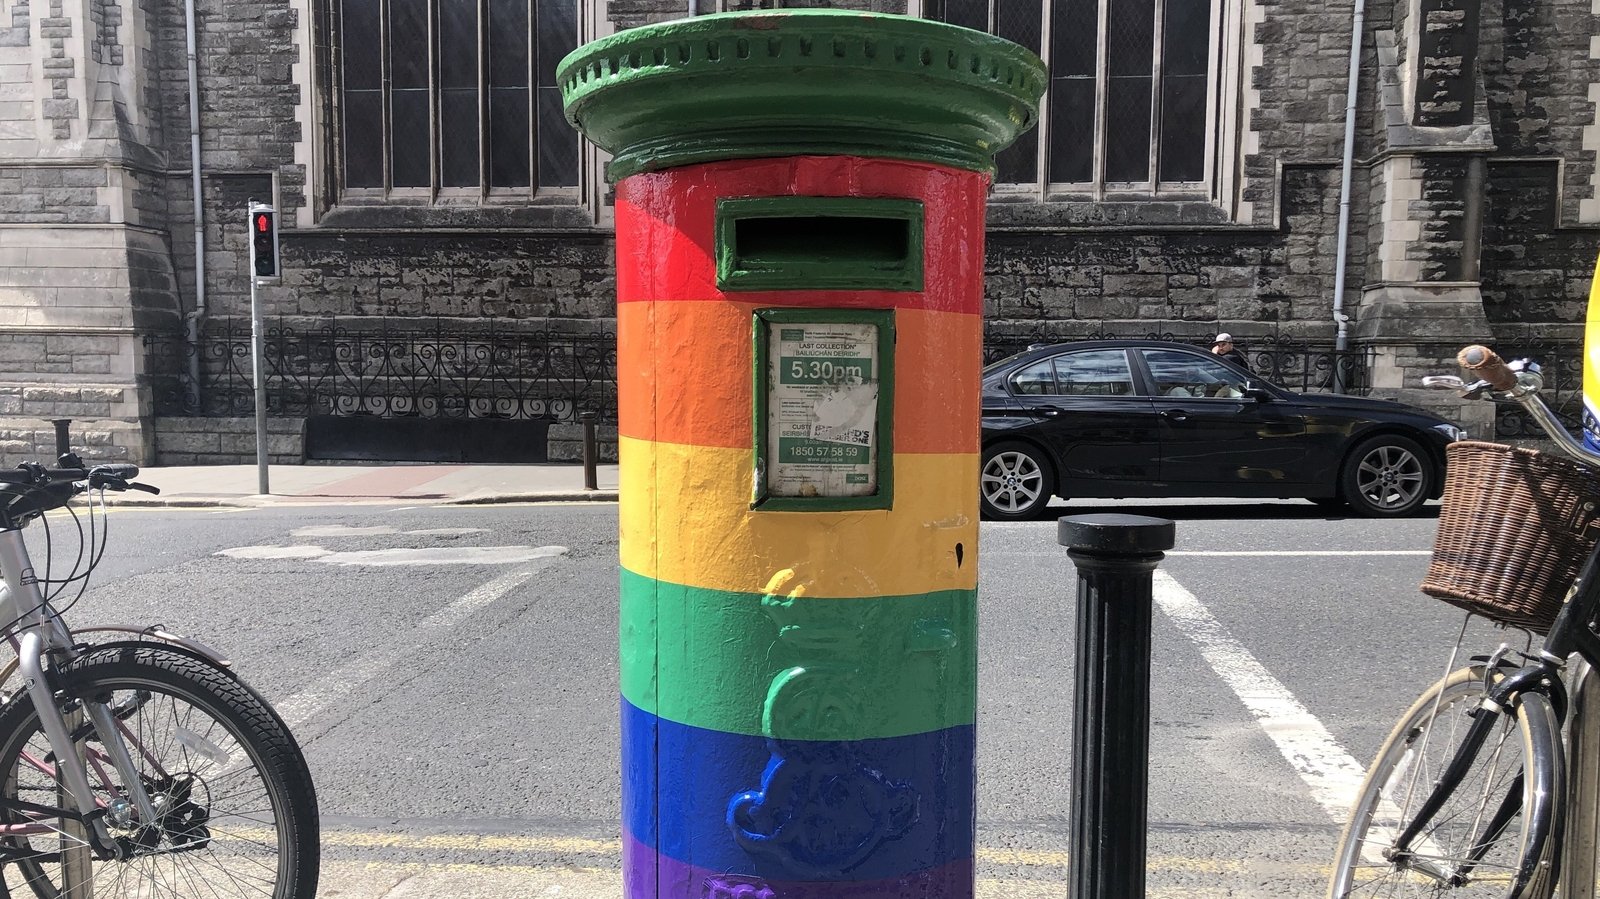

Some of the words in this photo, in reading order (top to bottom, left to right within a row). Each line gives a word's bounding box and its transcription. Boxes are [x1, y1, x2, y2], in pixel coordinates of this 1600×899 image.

[791, 361, 862, 384] 5.30pm
[790, 446, 814, 456] 1850
[816, 446, 829, 456] 57
[831, 447, 844, 457] 58
[845, 447, 858, 457] 59
